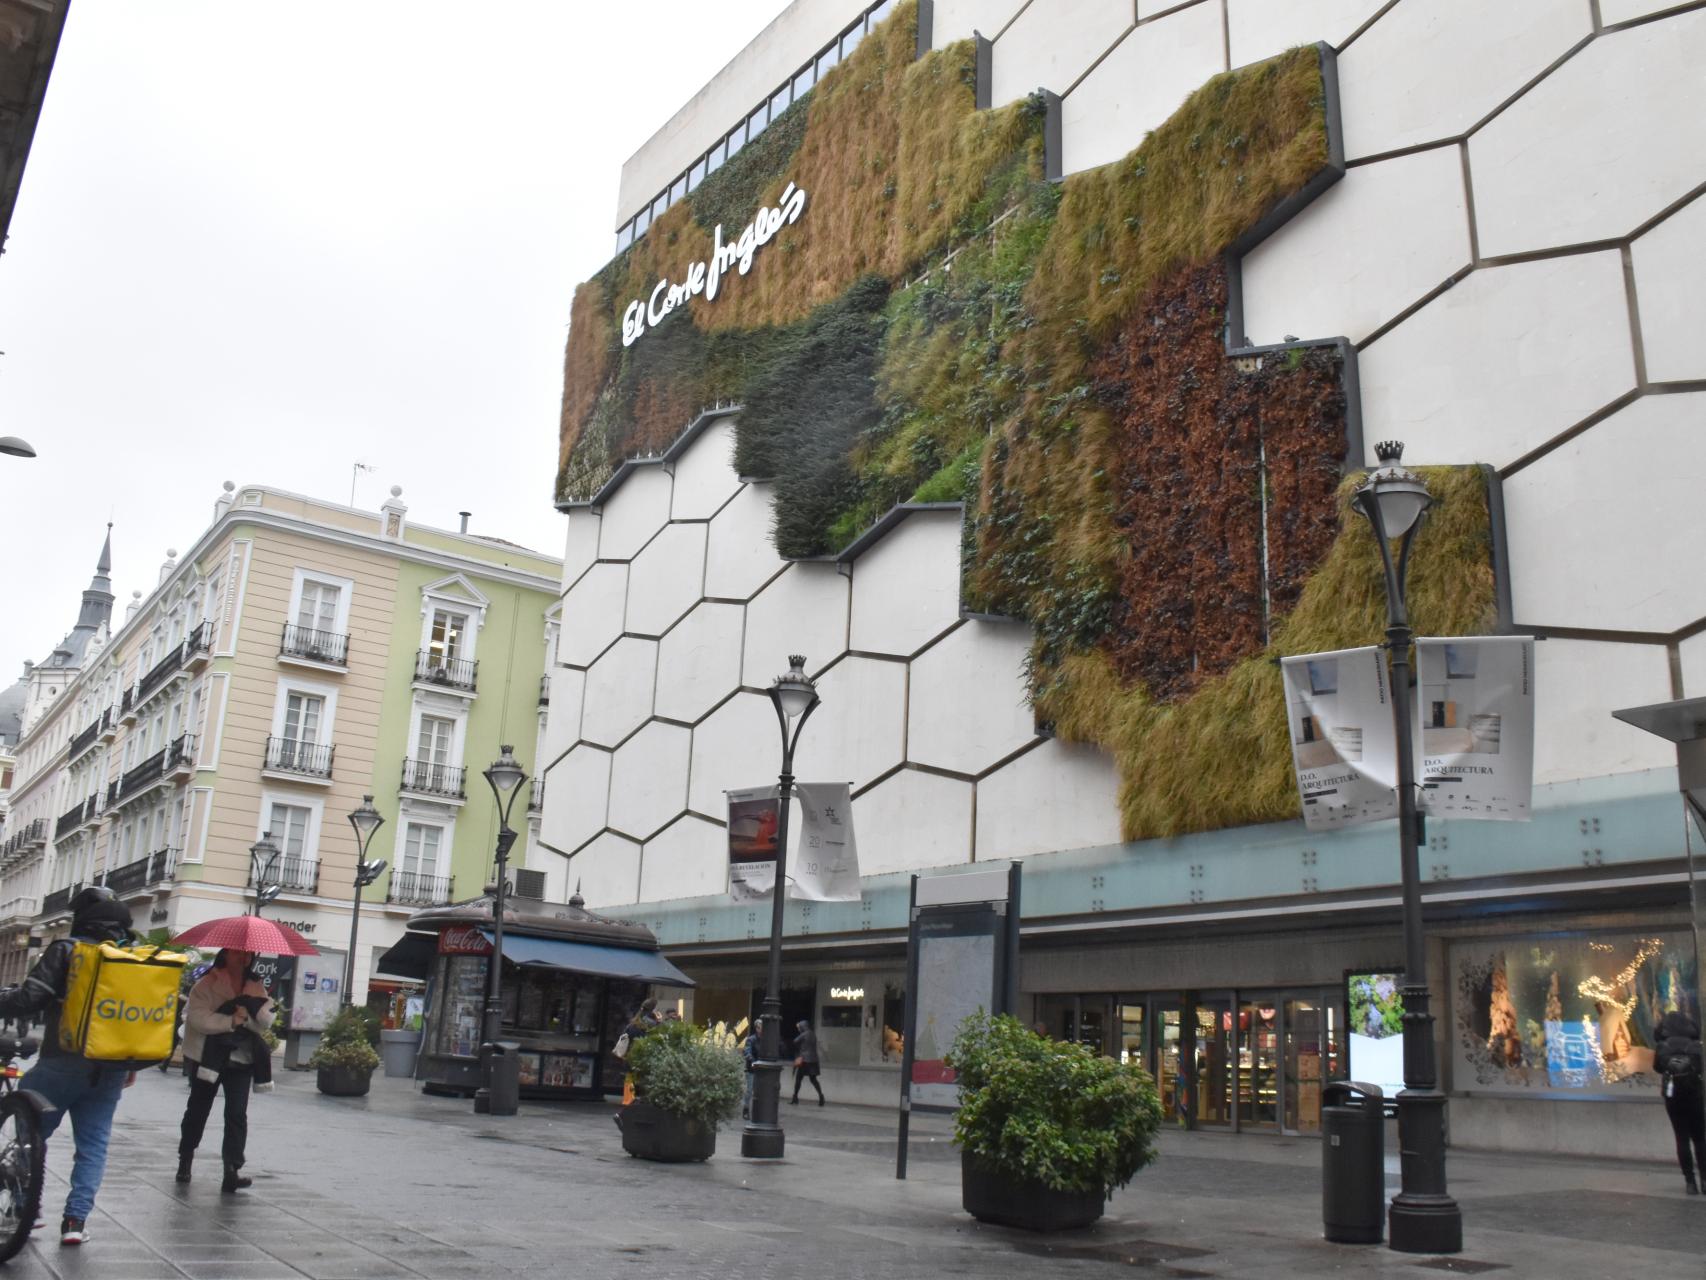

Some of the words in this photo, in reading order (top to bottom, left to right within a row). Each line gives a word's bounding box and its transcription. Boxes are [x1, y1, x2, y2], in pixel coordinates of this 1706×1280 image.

[622, 299, 646, 347] El
[647, 261, 706, 327] Corte
[706, 181, 806, 301] Inglés
[1424, 759, 1443, 767] D.O.
[1424, 766, 1494, 775] ARQUITECTURA
[1300, 773, 1317, 781] D.O.
[1302, 773, 1361, 790] ARQUITECTURA
[273, 918, 317, 933] tander
[96, 998, 164, 1022] Glovo
